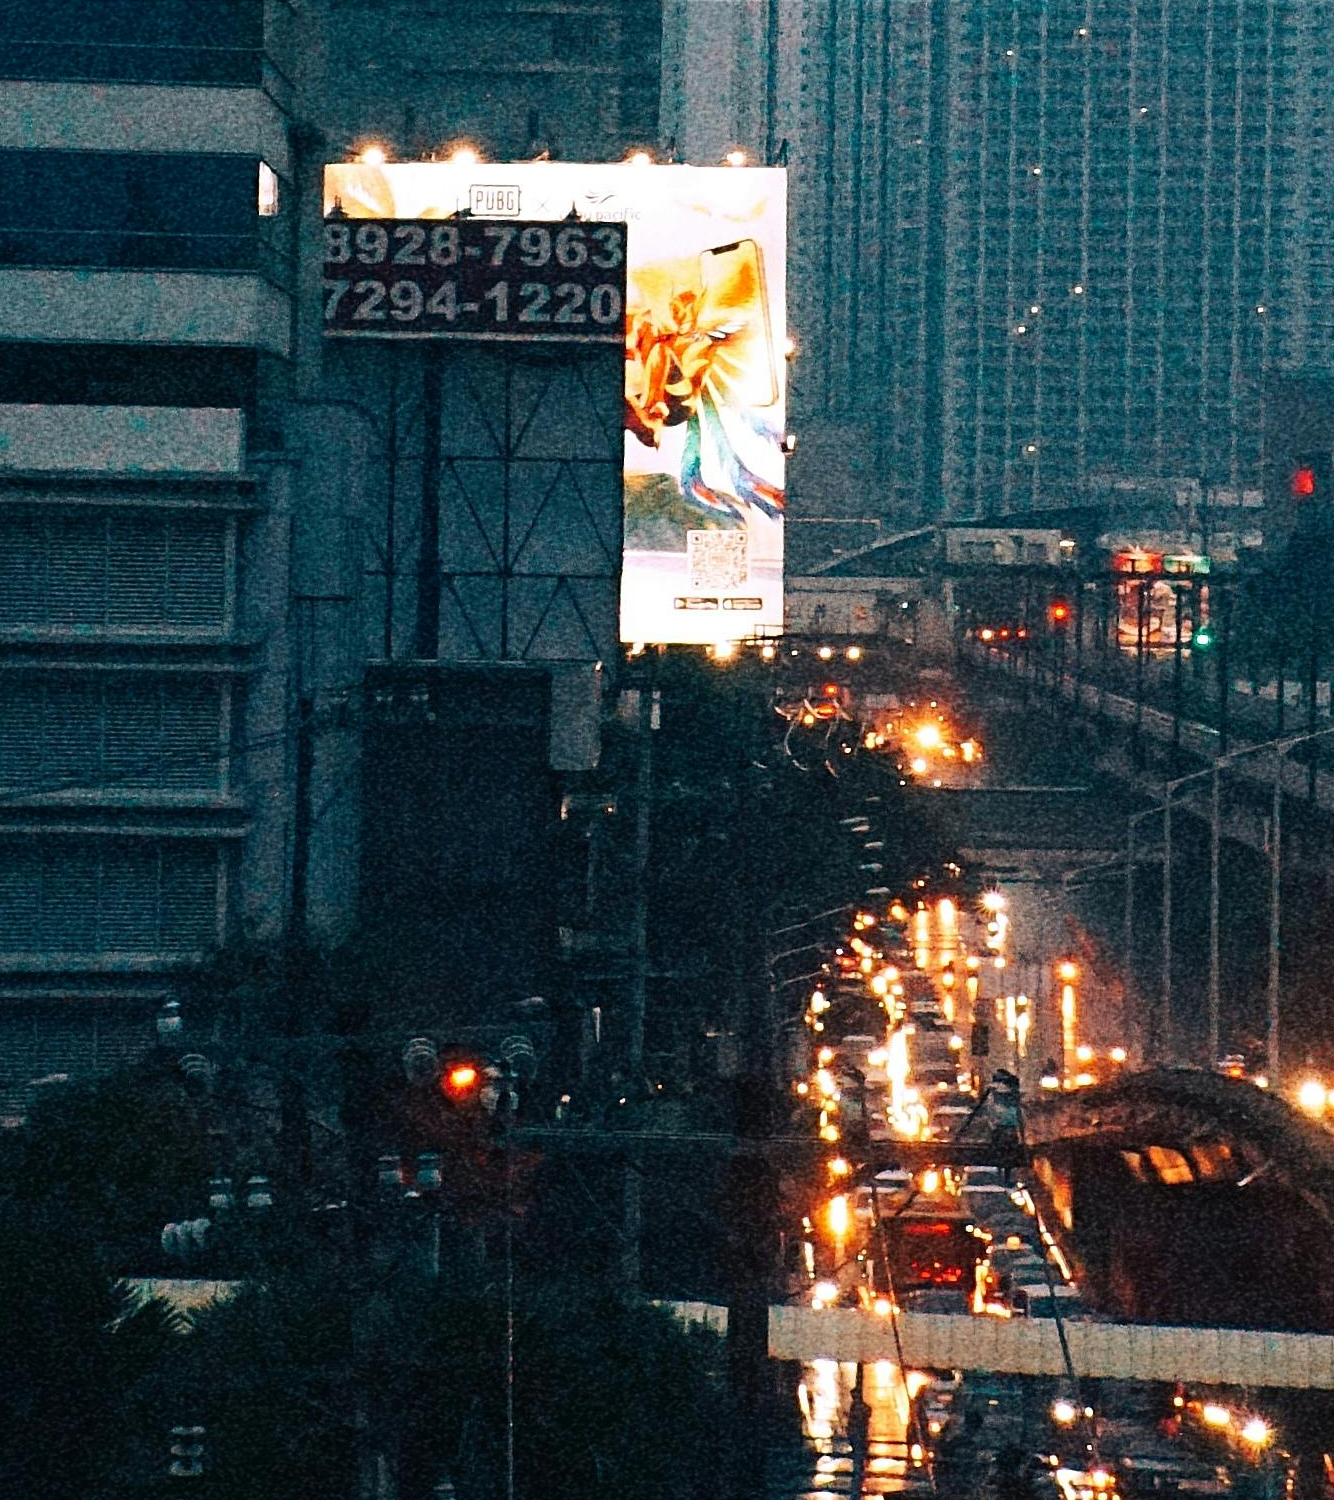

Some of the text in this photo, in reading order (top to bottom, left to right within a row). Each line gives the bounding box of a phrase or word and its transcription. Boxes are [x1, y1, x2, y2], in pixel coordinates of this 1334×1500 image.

[475, 190, 515, 212] PUBG
[323, 223, 623, 268] 8928-7963
[323, 279, 622, 324] 7294-1220
